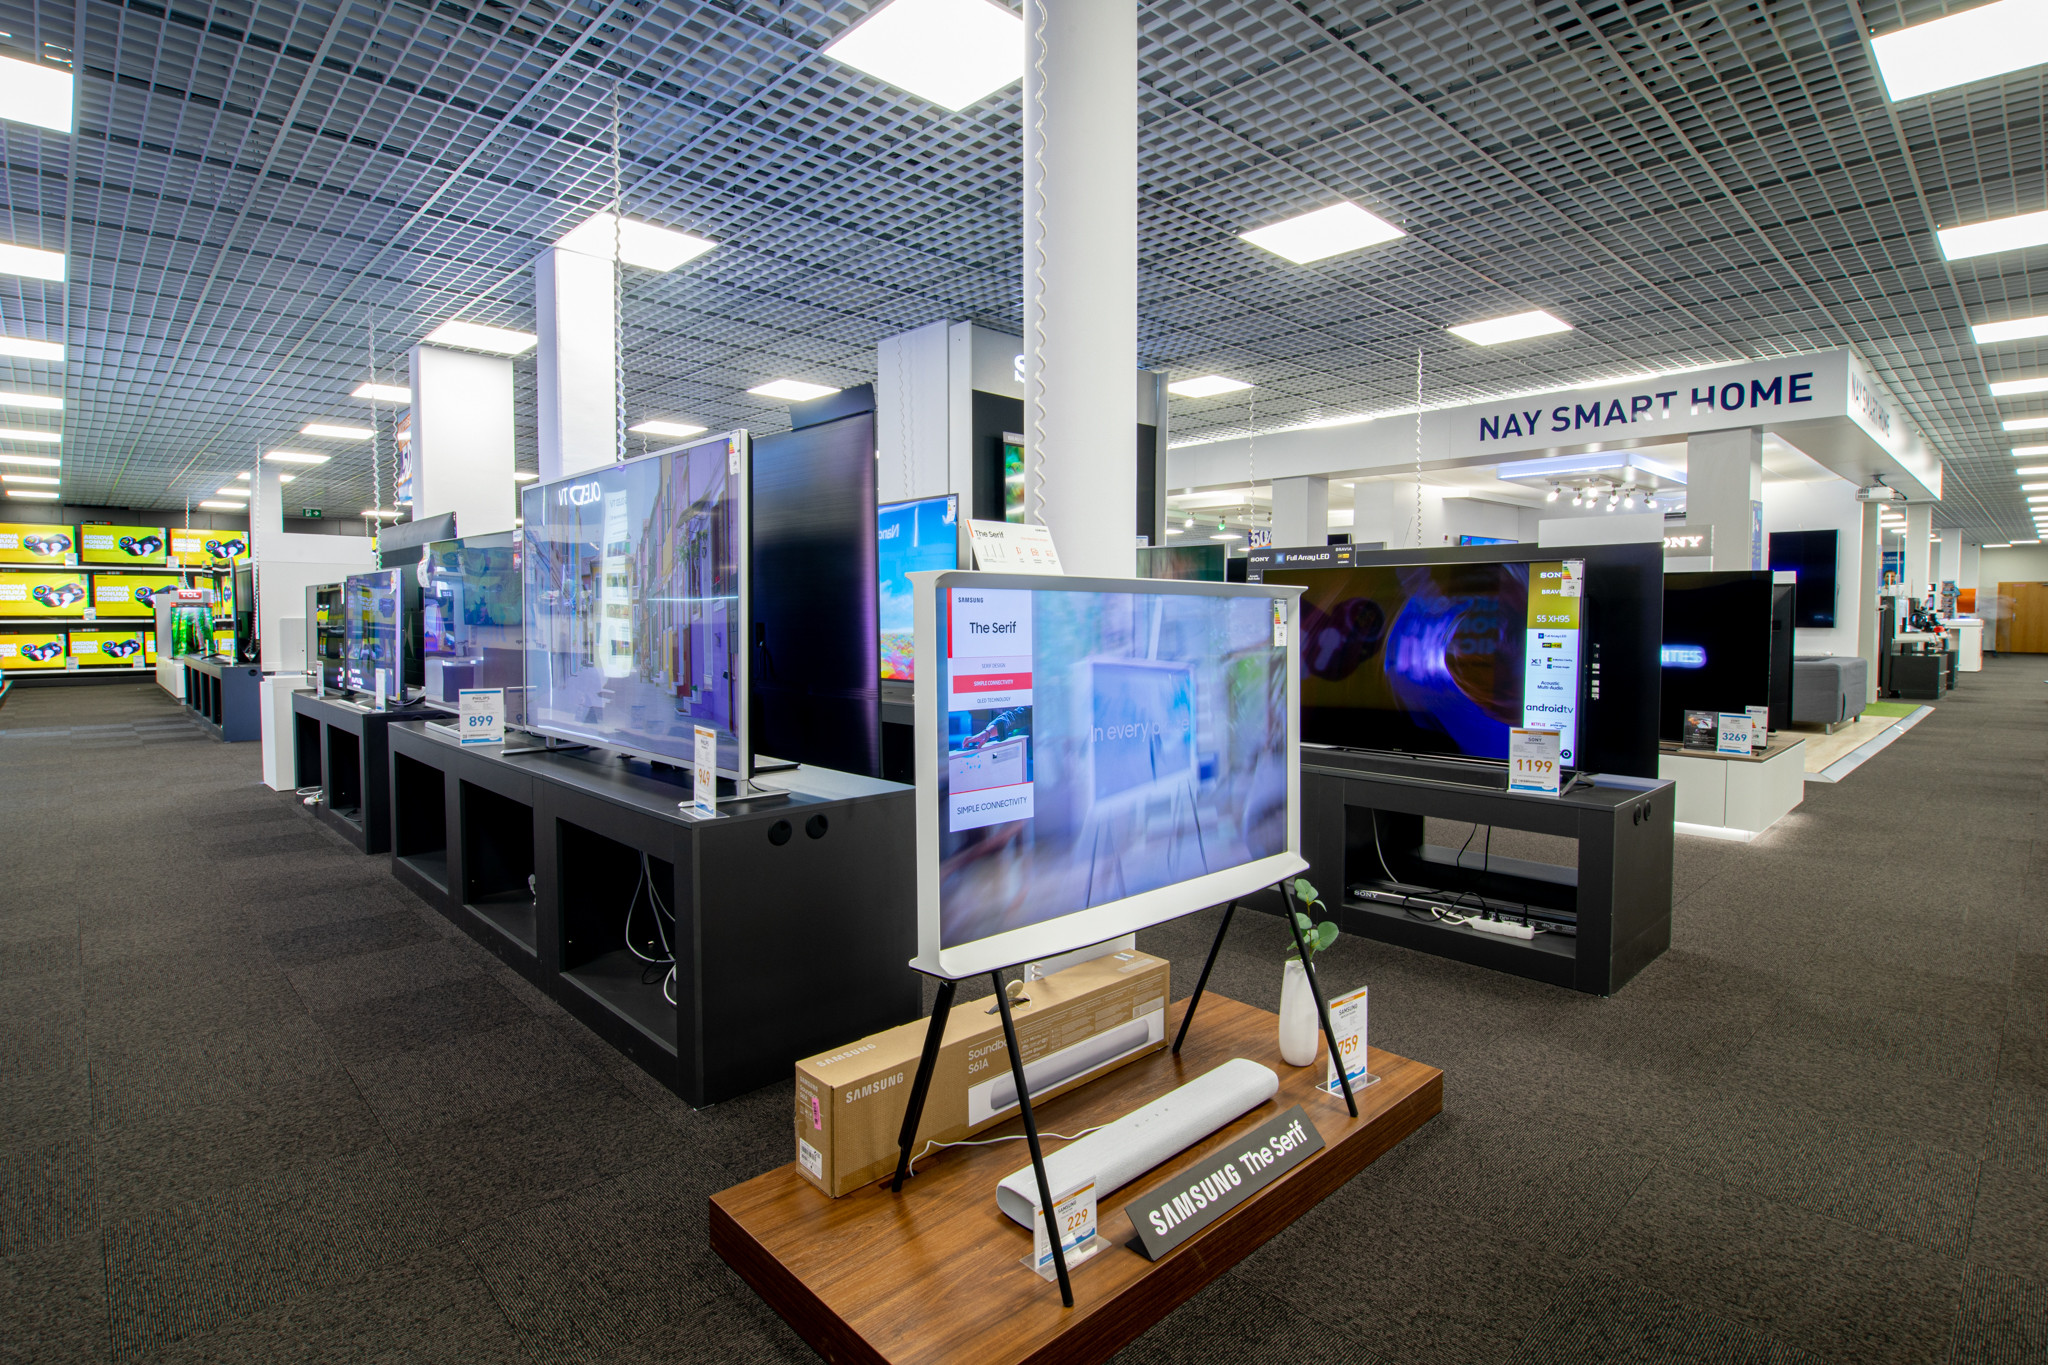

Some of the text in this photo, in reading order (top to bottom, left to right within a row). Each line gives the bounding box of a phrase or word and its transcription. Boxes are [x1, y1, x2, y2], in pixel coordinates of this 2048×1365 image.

[1479, 372, 1814, 441] NAY SMART HOME
[1663, 536, 1704, 548] ONY
[969, 621, 1017, 634] The Serif
[1536, 615, 1570, 623] 55 XH95
[469, 715, 494, 727] 899
[1107, 720, 1149, 742] every
[1722, 732, 1747, 742] 3269
[1517, 759, 1553, 773] 1199
[957, 796, 1027, 815] SIMPLE CONNECTIVITY
[1353, 889, 1378, 899] SONY
[1338, 1034, 1359, 1057] 759
[816, 1043, 877, 1068] SAMSUNG
[968, 1058, 989, 1074] S61A
[799, 1076, 819, 1093] SAMSUNG
[845, 1072, 904, 1104] SAMSUNG
[1148, 1119, 1308, 1236] SAMSUNG The Serif
[1067, 1208, 1088, 1231] 229
